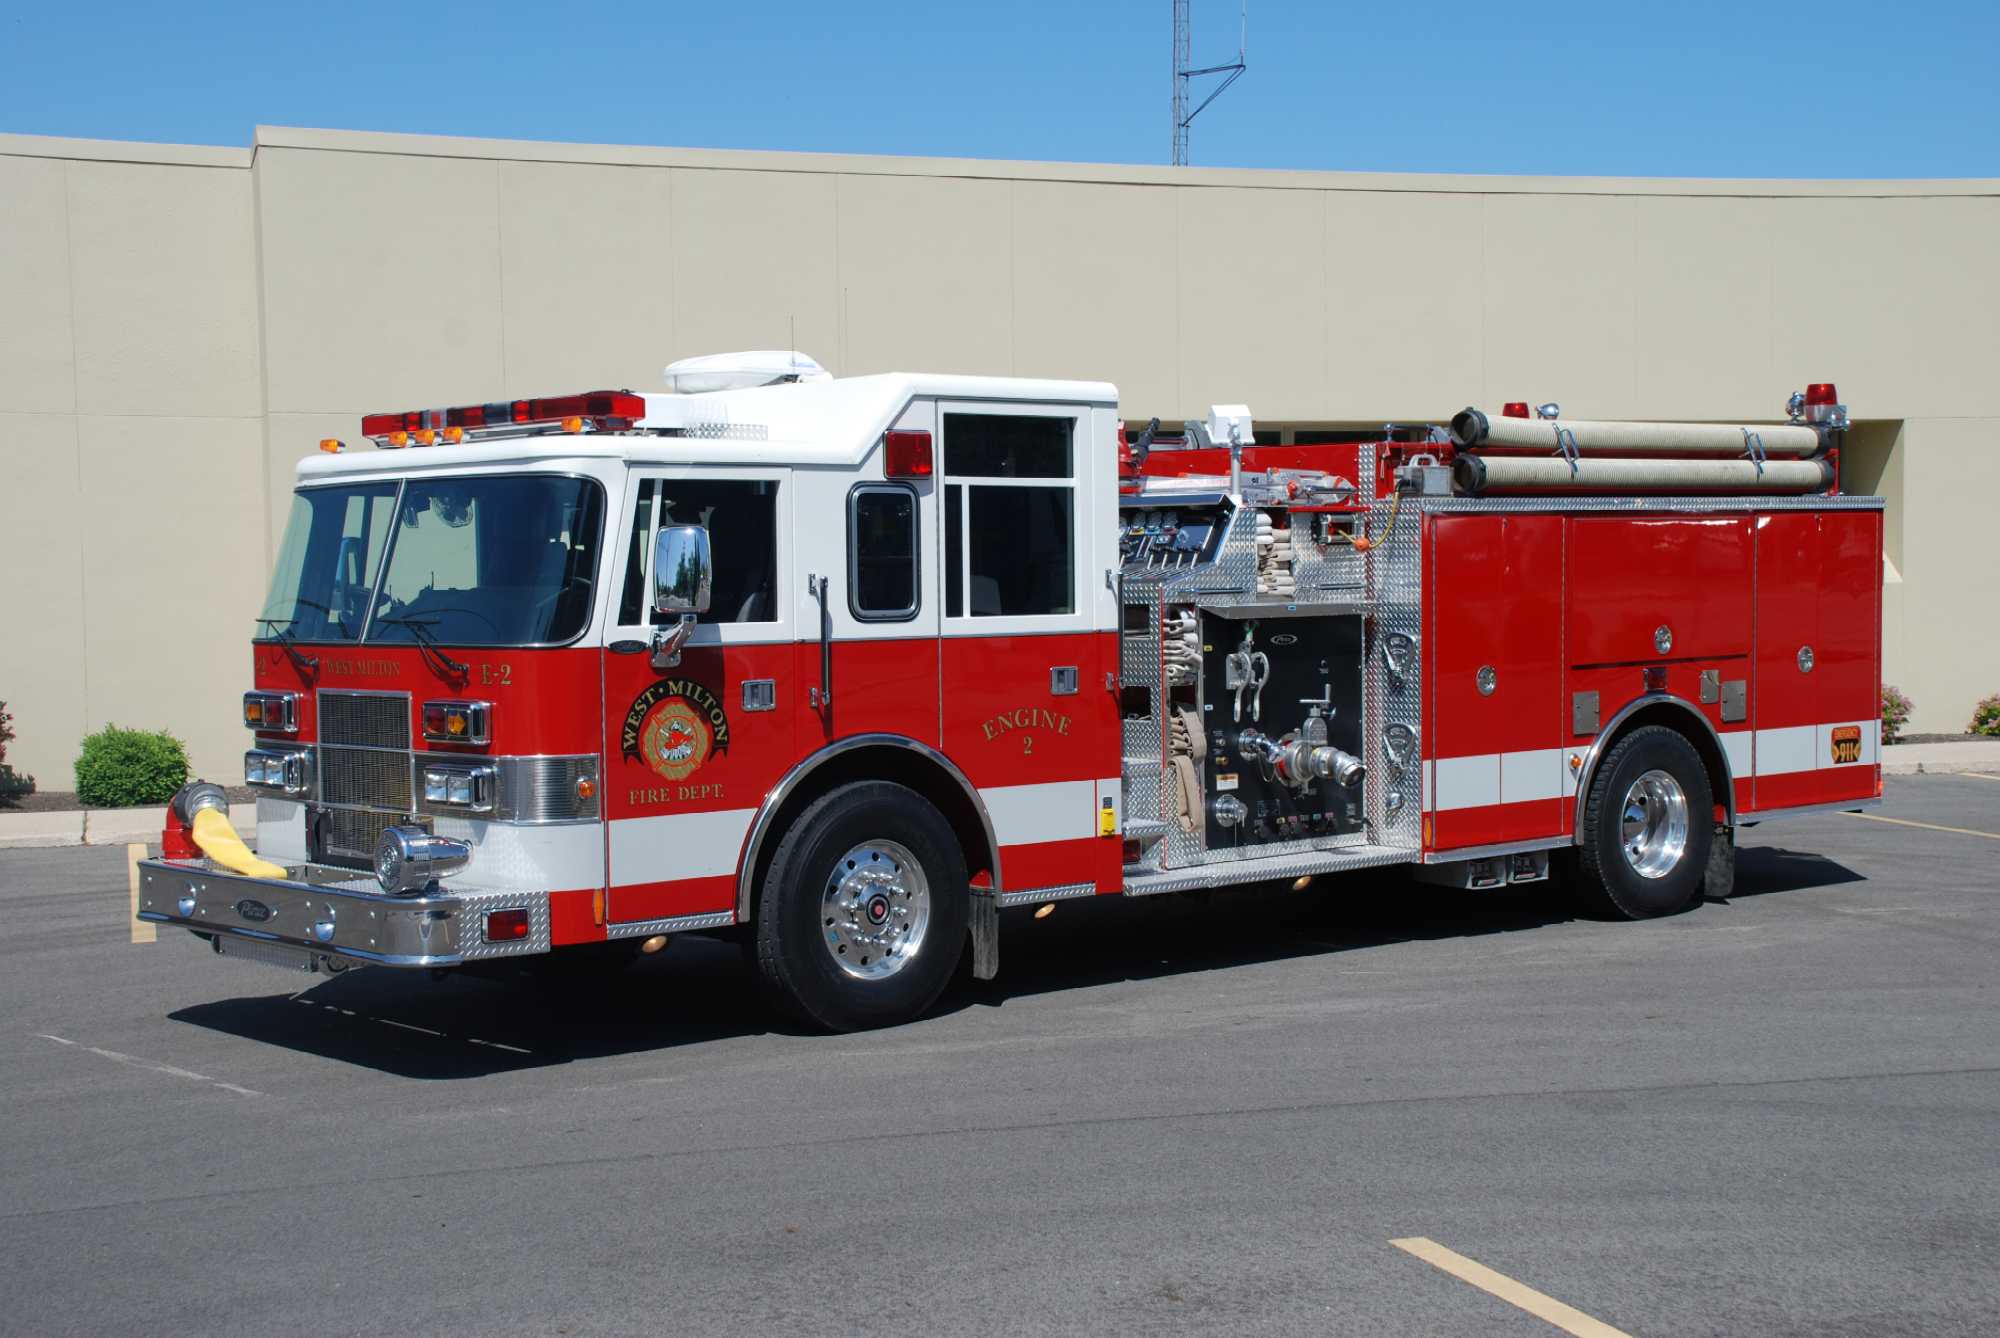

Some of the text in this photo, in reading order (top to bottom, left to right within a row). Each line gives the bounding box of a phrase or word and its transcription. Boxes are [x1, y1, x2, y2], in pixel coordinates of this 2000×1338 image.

[356, 661, 400, 677] MILTON
[623, 679, 728, 750] WEST MILTON
[982, 707, 1072, 741] ENGINE
[1023, 735, 1033, 755] 2
[1839, 742, 1854, 762] 911
[629, 783, 725, 805] FIRE DEPT.
